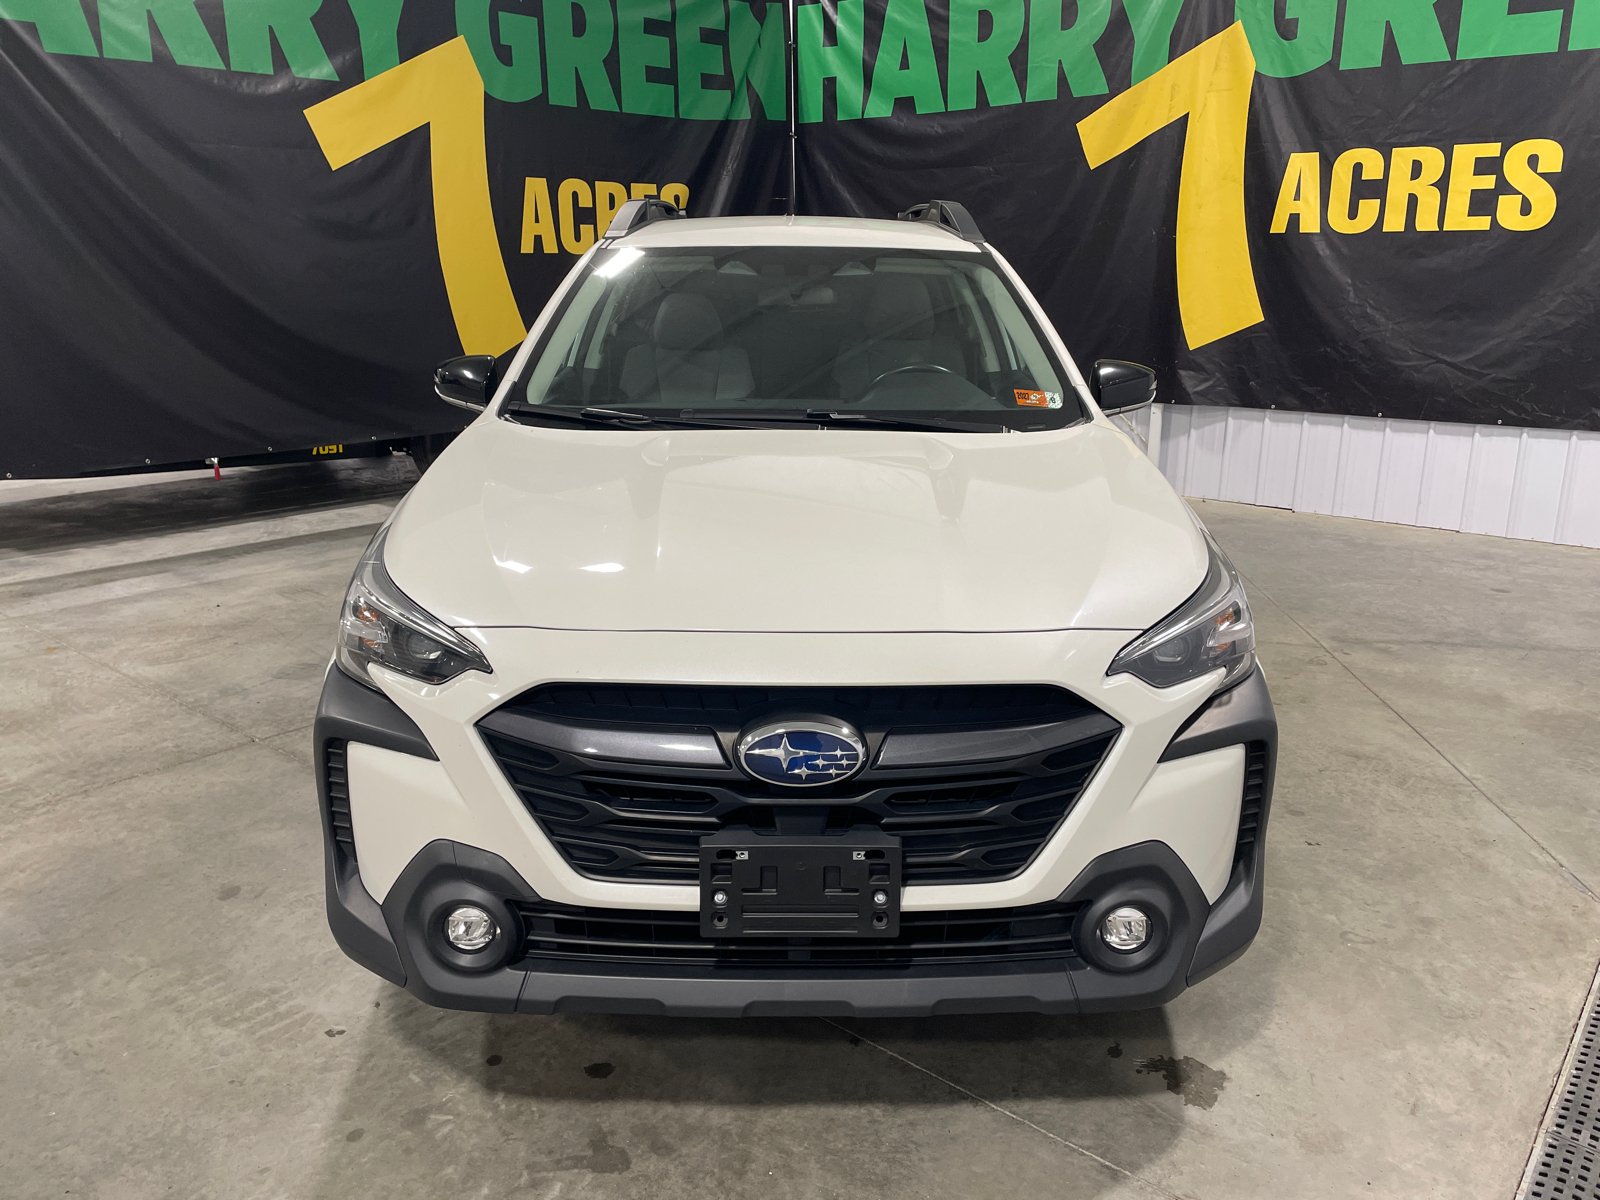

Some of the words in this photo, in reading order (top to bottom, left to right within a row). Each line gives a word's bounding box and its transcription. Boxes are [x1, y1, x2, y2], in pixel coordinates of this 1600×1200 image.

[455, 0, 787, 121] GREEN
[798, 0, 1184, 124] HARRY
[303, 35, 528, 359] 7
[520, 176, 690, 255] ACR
[1077, 20, 1265, 351] 7
[1269, 138, 1564, 234] ACRES
